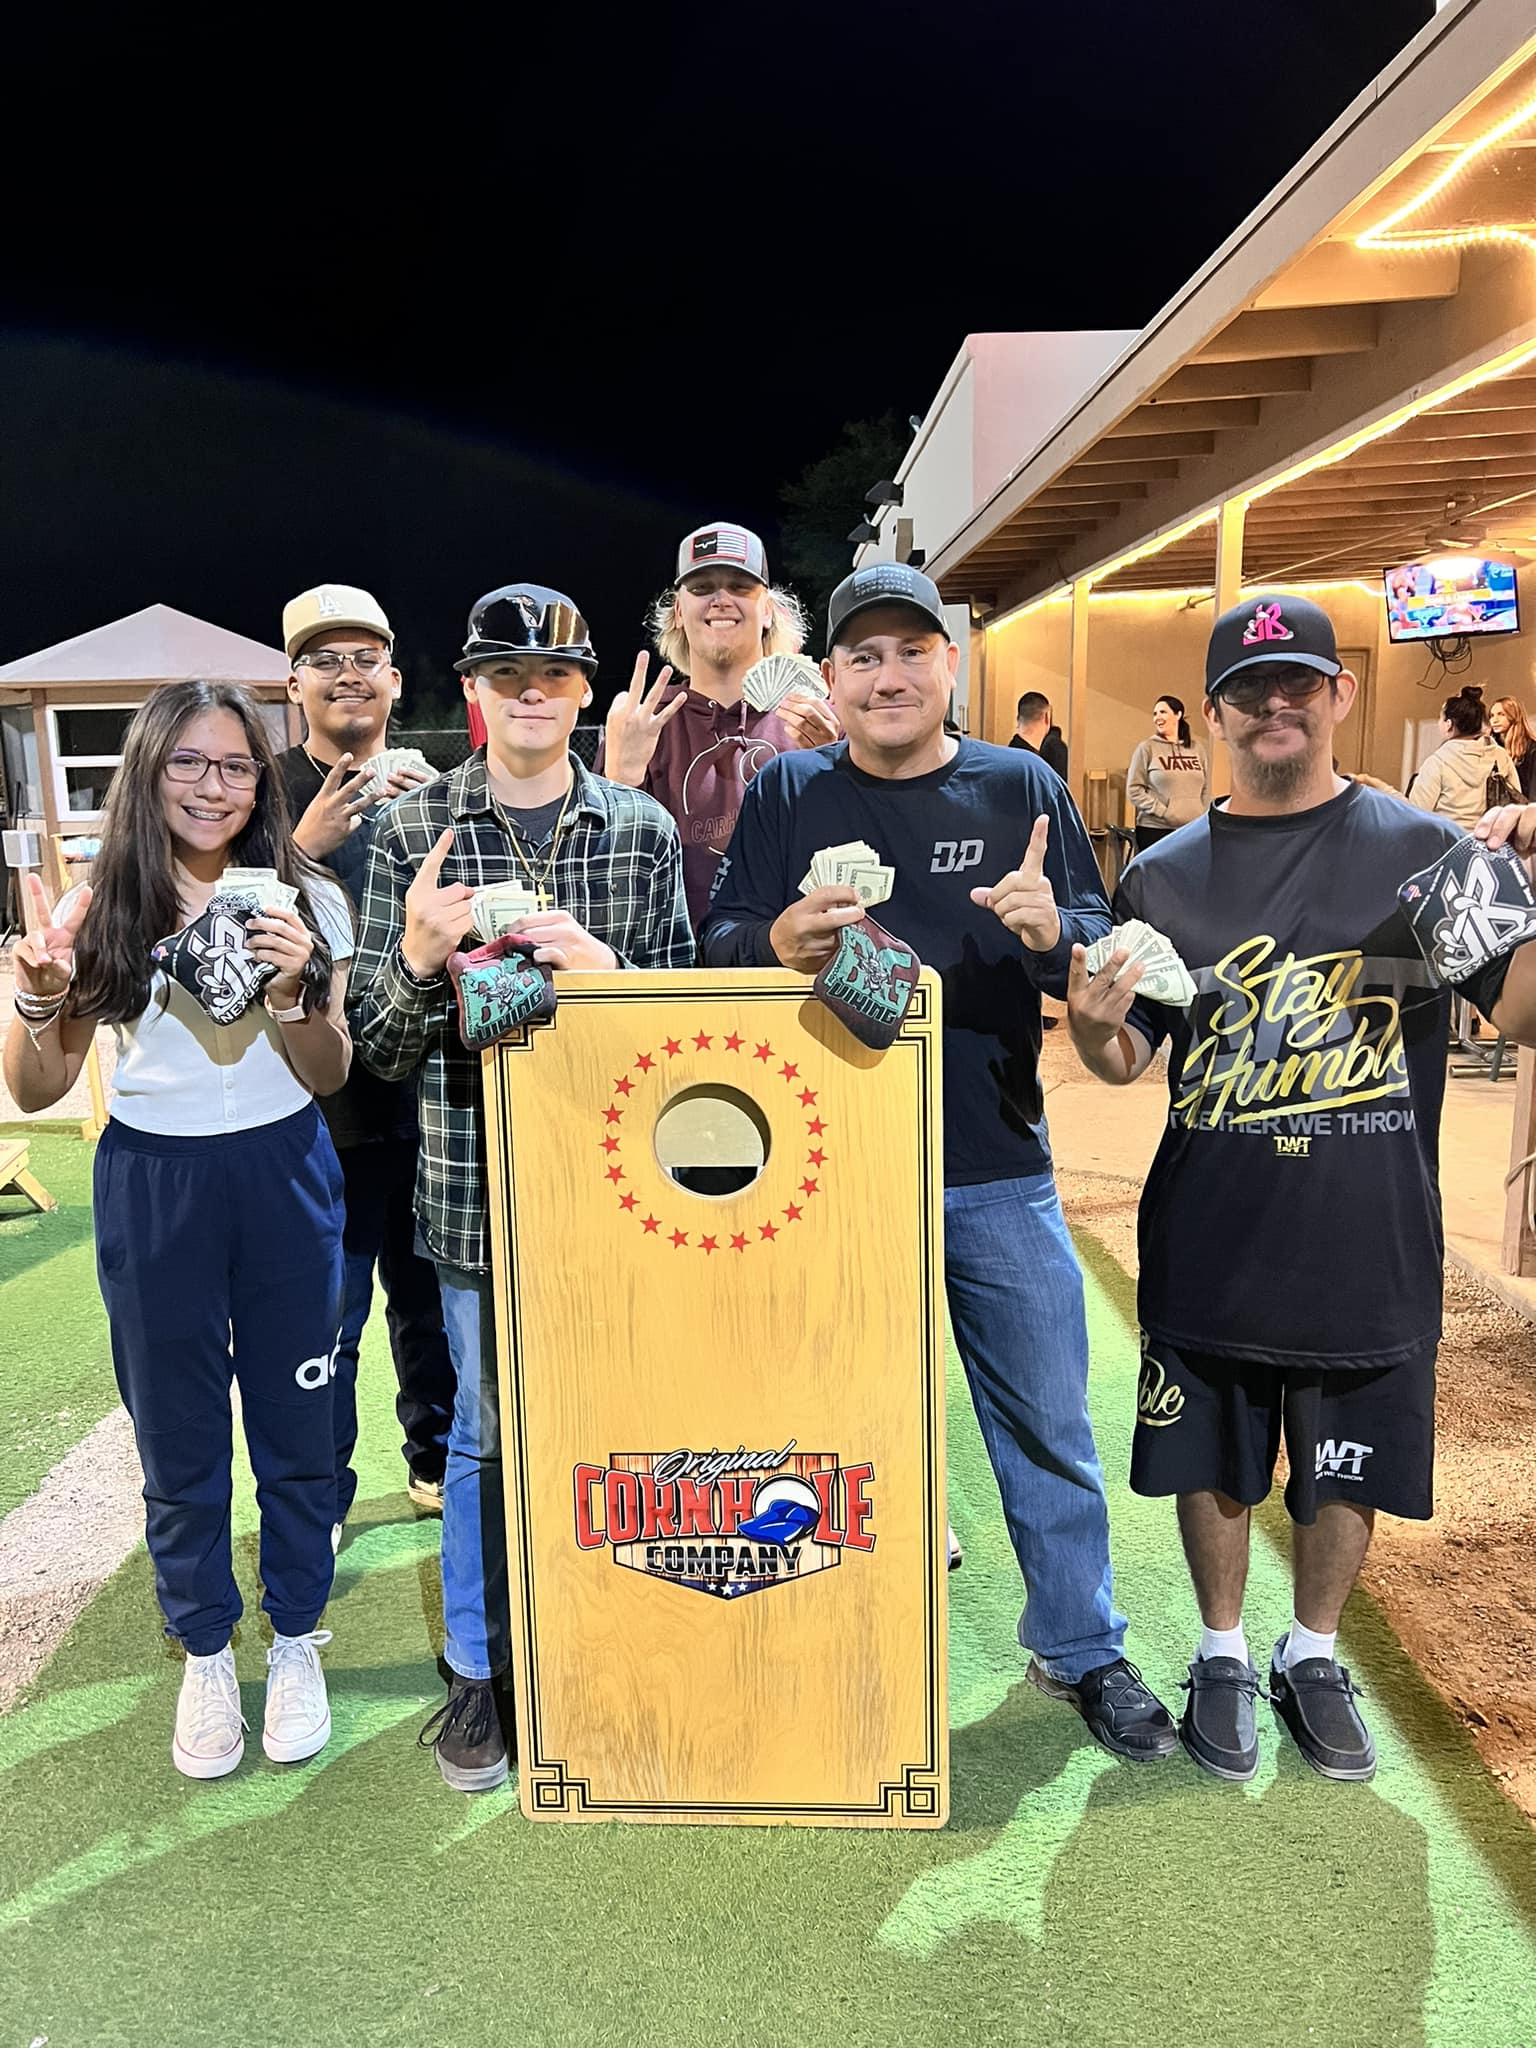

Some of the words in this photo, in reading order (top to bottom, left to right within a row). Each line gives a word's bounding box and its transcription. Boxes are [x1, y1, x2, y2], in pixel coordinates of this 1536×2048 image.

[1159, 755, 1202, 771] VANS
[930, 839, 984, 873] DP
[1449, 940, 1509, 983] NEXUS
[827, 982, 898, 1026] VIKING
[1209, 935, 1399, 1048] Stay
[1287, 1111, 1333, 1136] WE
[654, 1439, 797, 1486] Original
[646, 1546, 802, 1577] COMPANY
